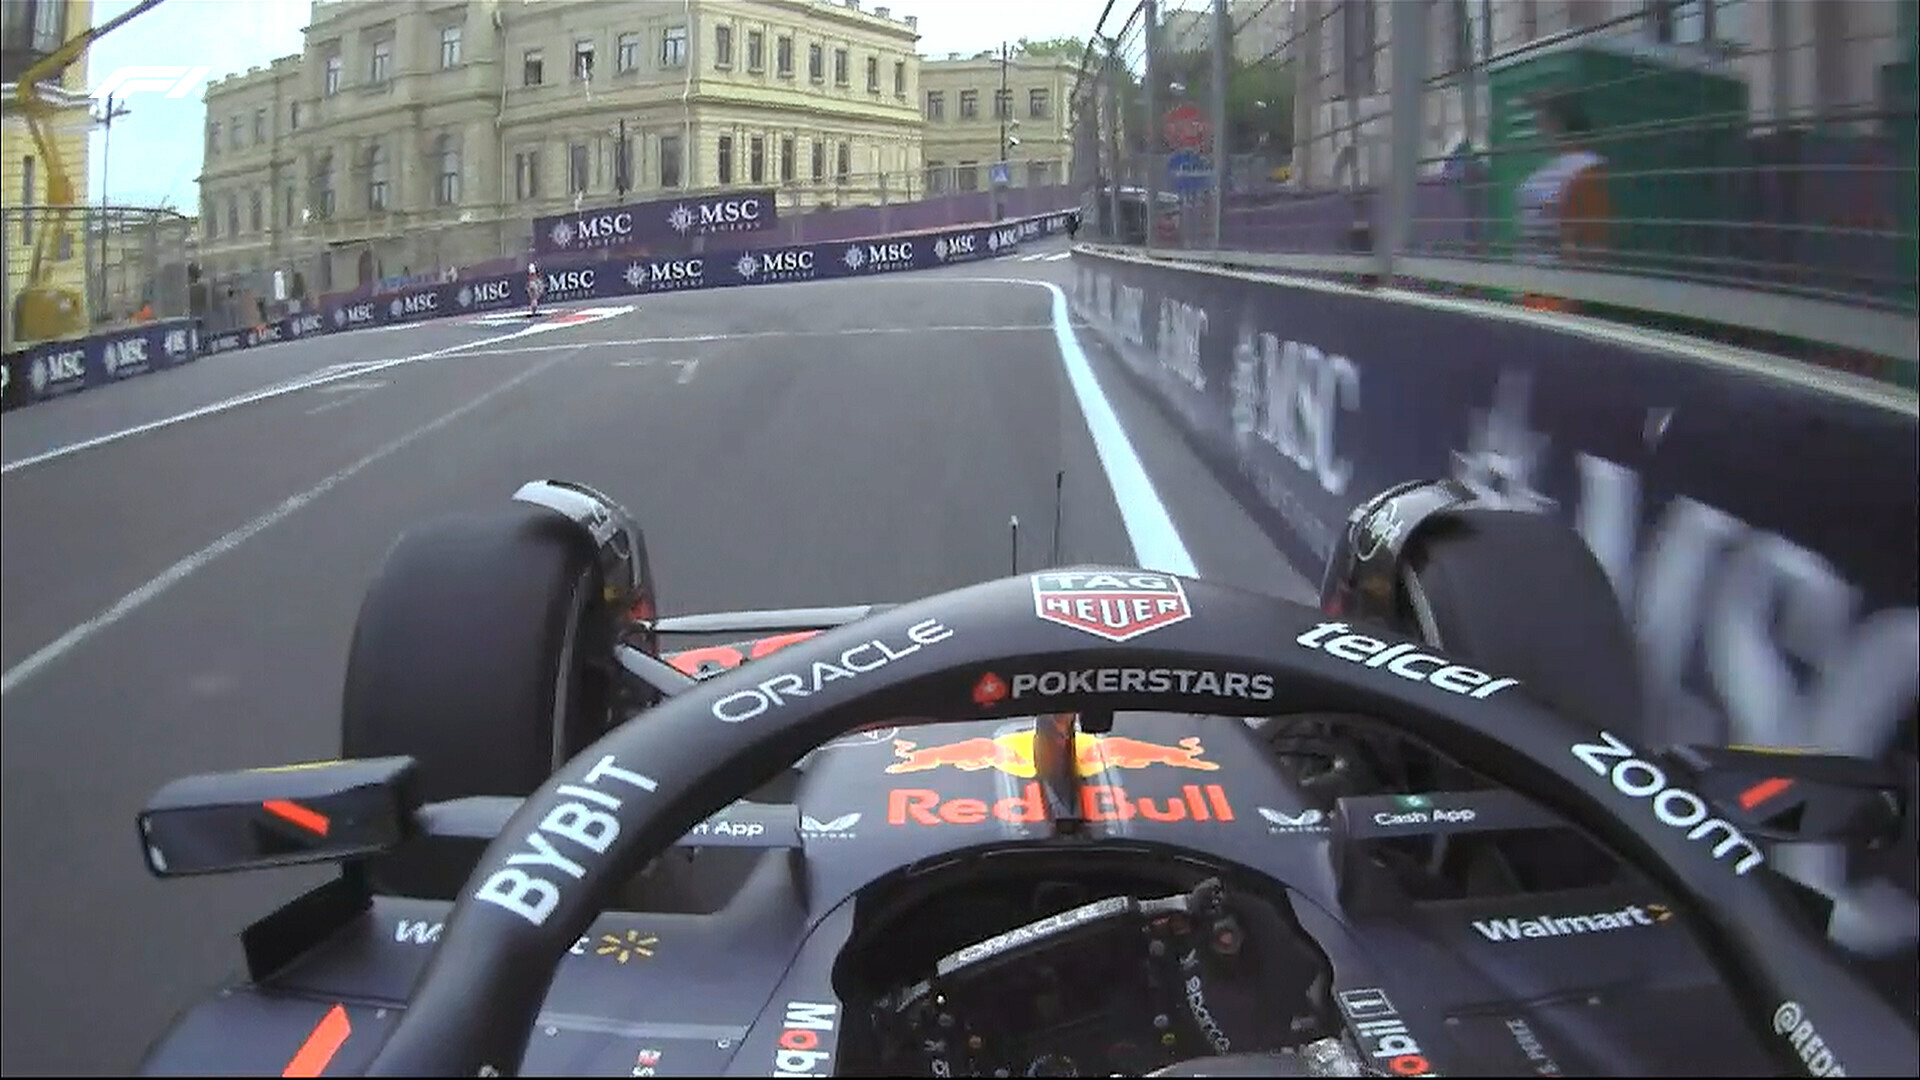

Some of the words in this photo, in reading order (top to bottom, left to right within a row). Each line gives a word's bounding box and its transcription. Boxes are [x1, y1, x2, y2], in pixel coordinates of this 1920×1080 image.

[699, 199, 759, 225] MSC
[577, 213, 632, 239] MSC
[868, 242, 913, 263] MSC
[949, 235, 975, 253] MSC
[650, 259, 703, 282] MSC
[763, 251, 815, 272] MSC
[474, 281, 510, 301] MSC
[549, 270, 595, 292] MSC
[404, 293, 438, 314] MSC
[1041, 574, 1168, 590] TAG
[1046, 597, 1179, 629] HEUER
[712, 617, 954, 723] ORACLE
[1296, 621, 1522, 699] telcel
[1011, 667, 1276, 702] POKERSTARS
[887, 782, 1047, 826] Red
[1078, 783, 1235, 822] Bull
[1571, 731, 1765, 876] zoom
[713, 820, 765, 837] App
[1432, 809, 1477, 824] App
[473, 754, 659, 927] BYBIT
[1472, 904, 1653, 942] Walmart
